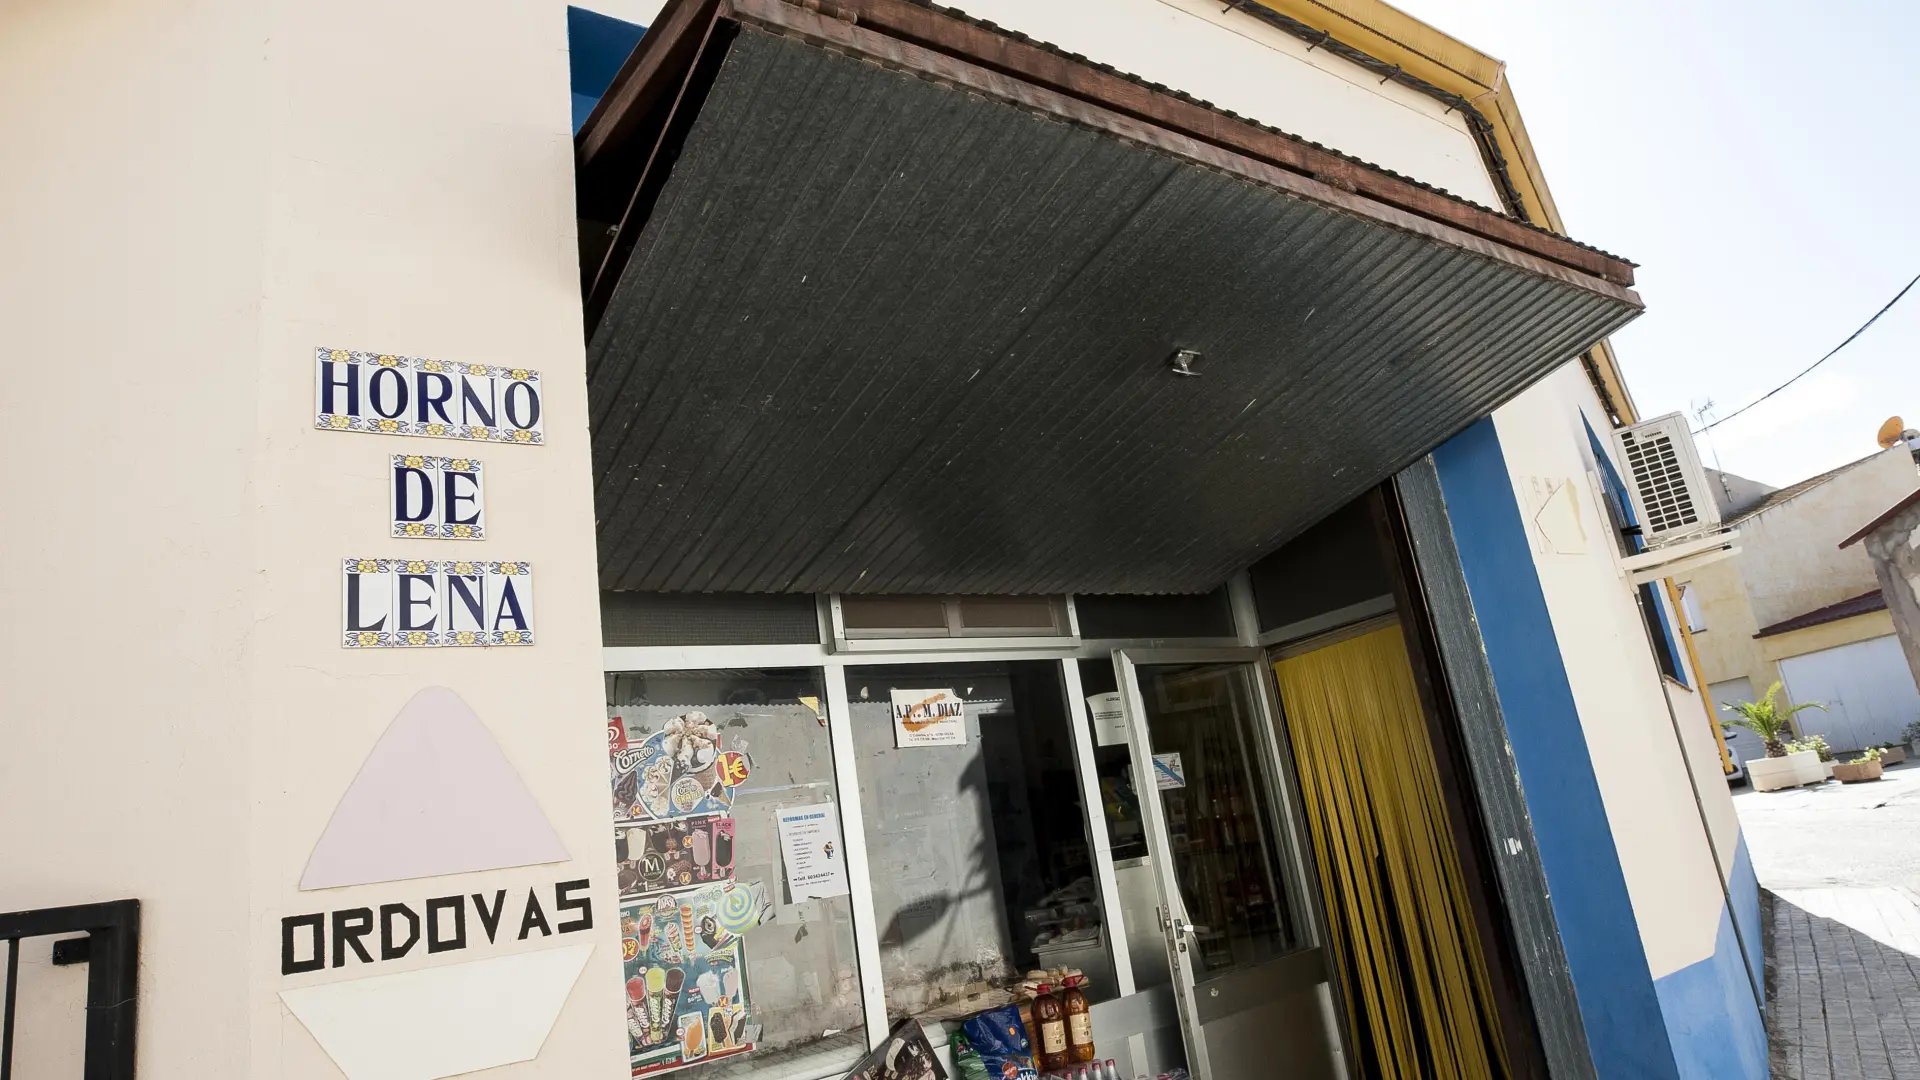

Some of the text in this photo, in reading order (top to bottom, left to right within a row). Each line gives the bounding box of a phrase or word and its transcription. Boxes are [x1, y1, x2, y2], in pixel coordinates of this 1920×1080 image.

[320, 360, 541, 430] HORNO
[394, 466, 482, 526] DE
[345, 573, 529, 632] LEÑA
[937, 703, 962, 717] DIAZ
[613, 745, 655, 774] Cornetto
[717, 754, 747, 787] 1€
[281, 878, 593, 976] ORDOVAS
